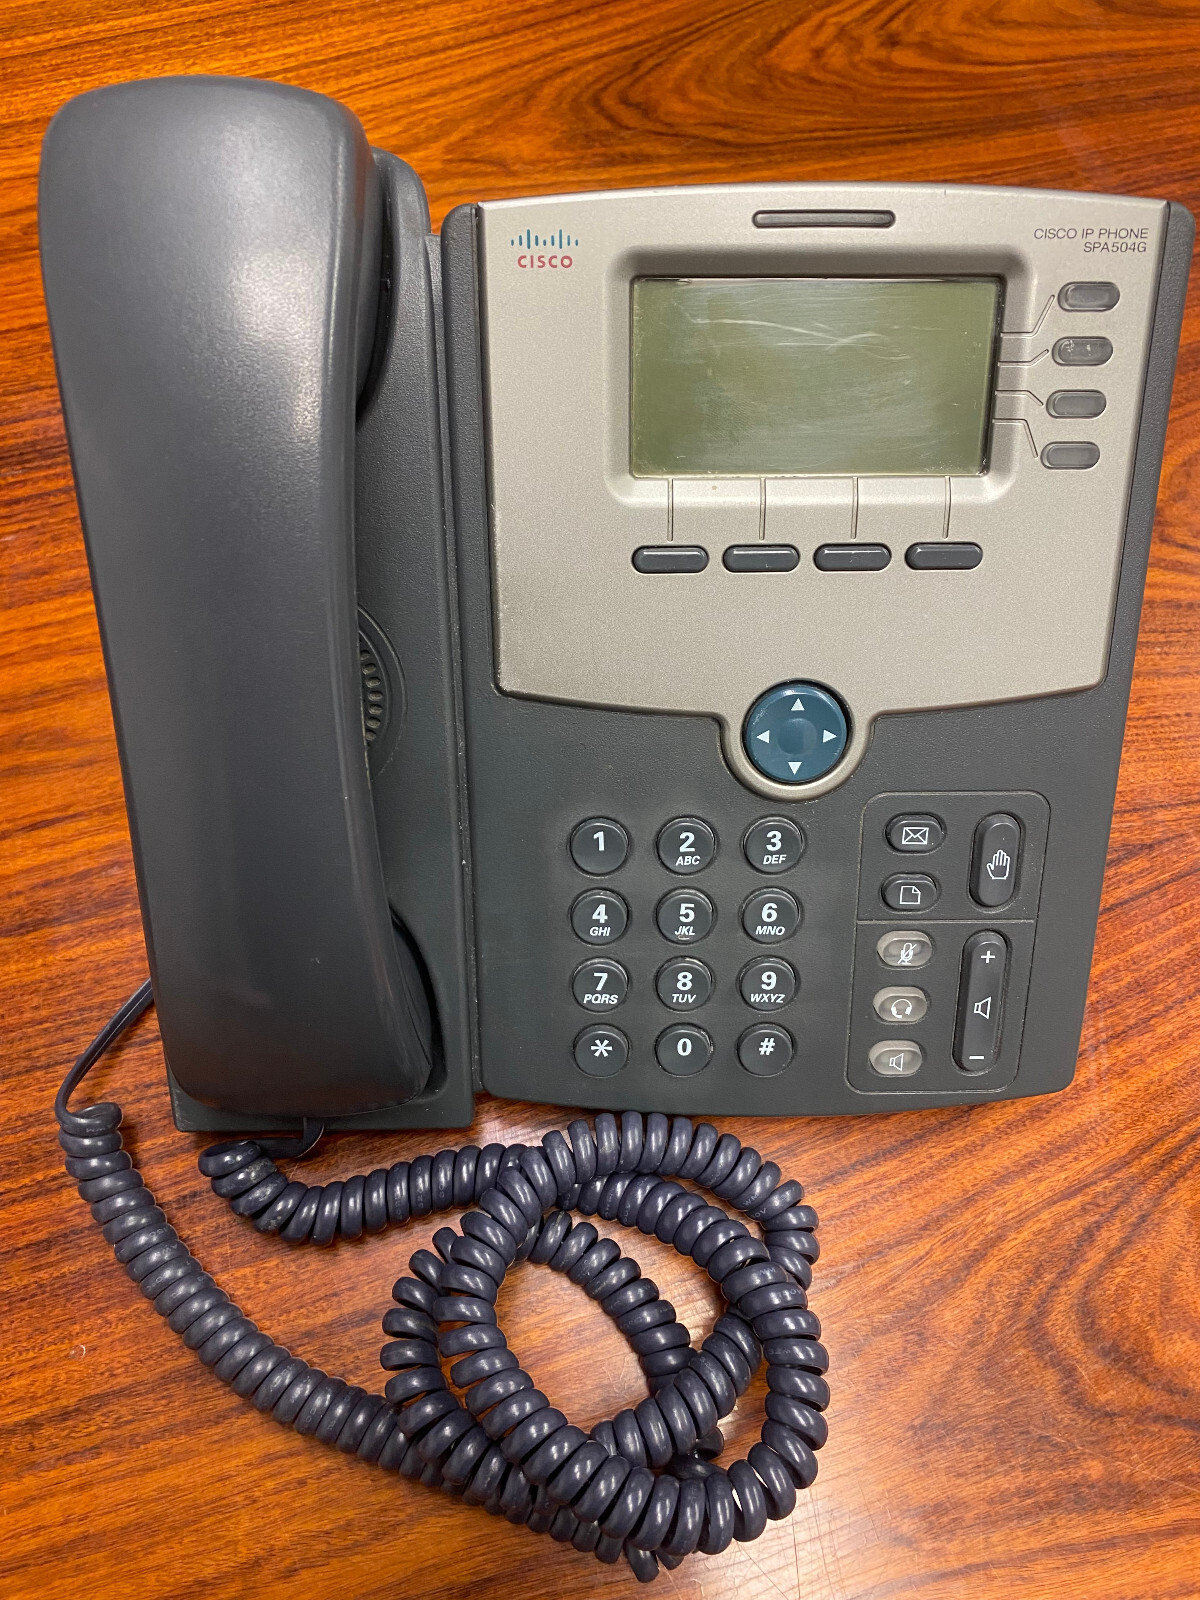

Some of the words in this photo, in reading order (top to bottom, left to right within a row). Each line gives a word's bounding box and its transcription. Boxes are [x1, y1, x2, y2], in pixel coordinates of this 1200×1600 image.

[1033, 228, 1077, 239] CISCO
[1081, 228, 1094, 239] IP
[1099, 228, 1149, 239] PHONE
[1083, 242, 1147, 253] SPA504G
[517, 255, 573, 268] CISCO
[593, 832, 604, 851] 1
[680, 832, 695, 852] 2
[766, 831, 781, 851] 3
[675, 856, 700, 866] ABC
[763, 854, 787, 864] DEF
[592, 904, 608, 923] 4
[679, 903, 694, 922] 5
[762, 903, 777, 922] 6
[590, 927, 610, 936] GHI
[675, 926, 695, 936] JKL
[755, 926, 785, 935] MNO
[594, 973, 608, 991] 7
[677, 972, 692, 990] 8
[761, 971, 776, 990] 9
[583, 994, 618, 1004] PQRS
[672, 994, 696, 1003] TUV
[751, 994, 785, 1003] WXYZ
[677, 1038, 692, 1056] 0
